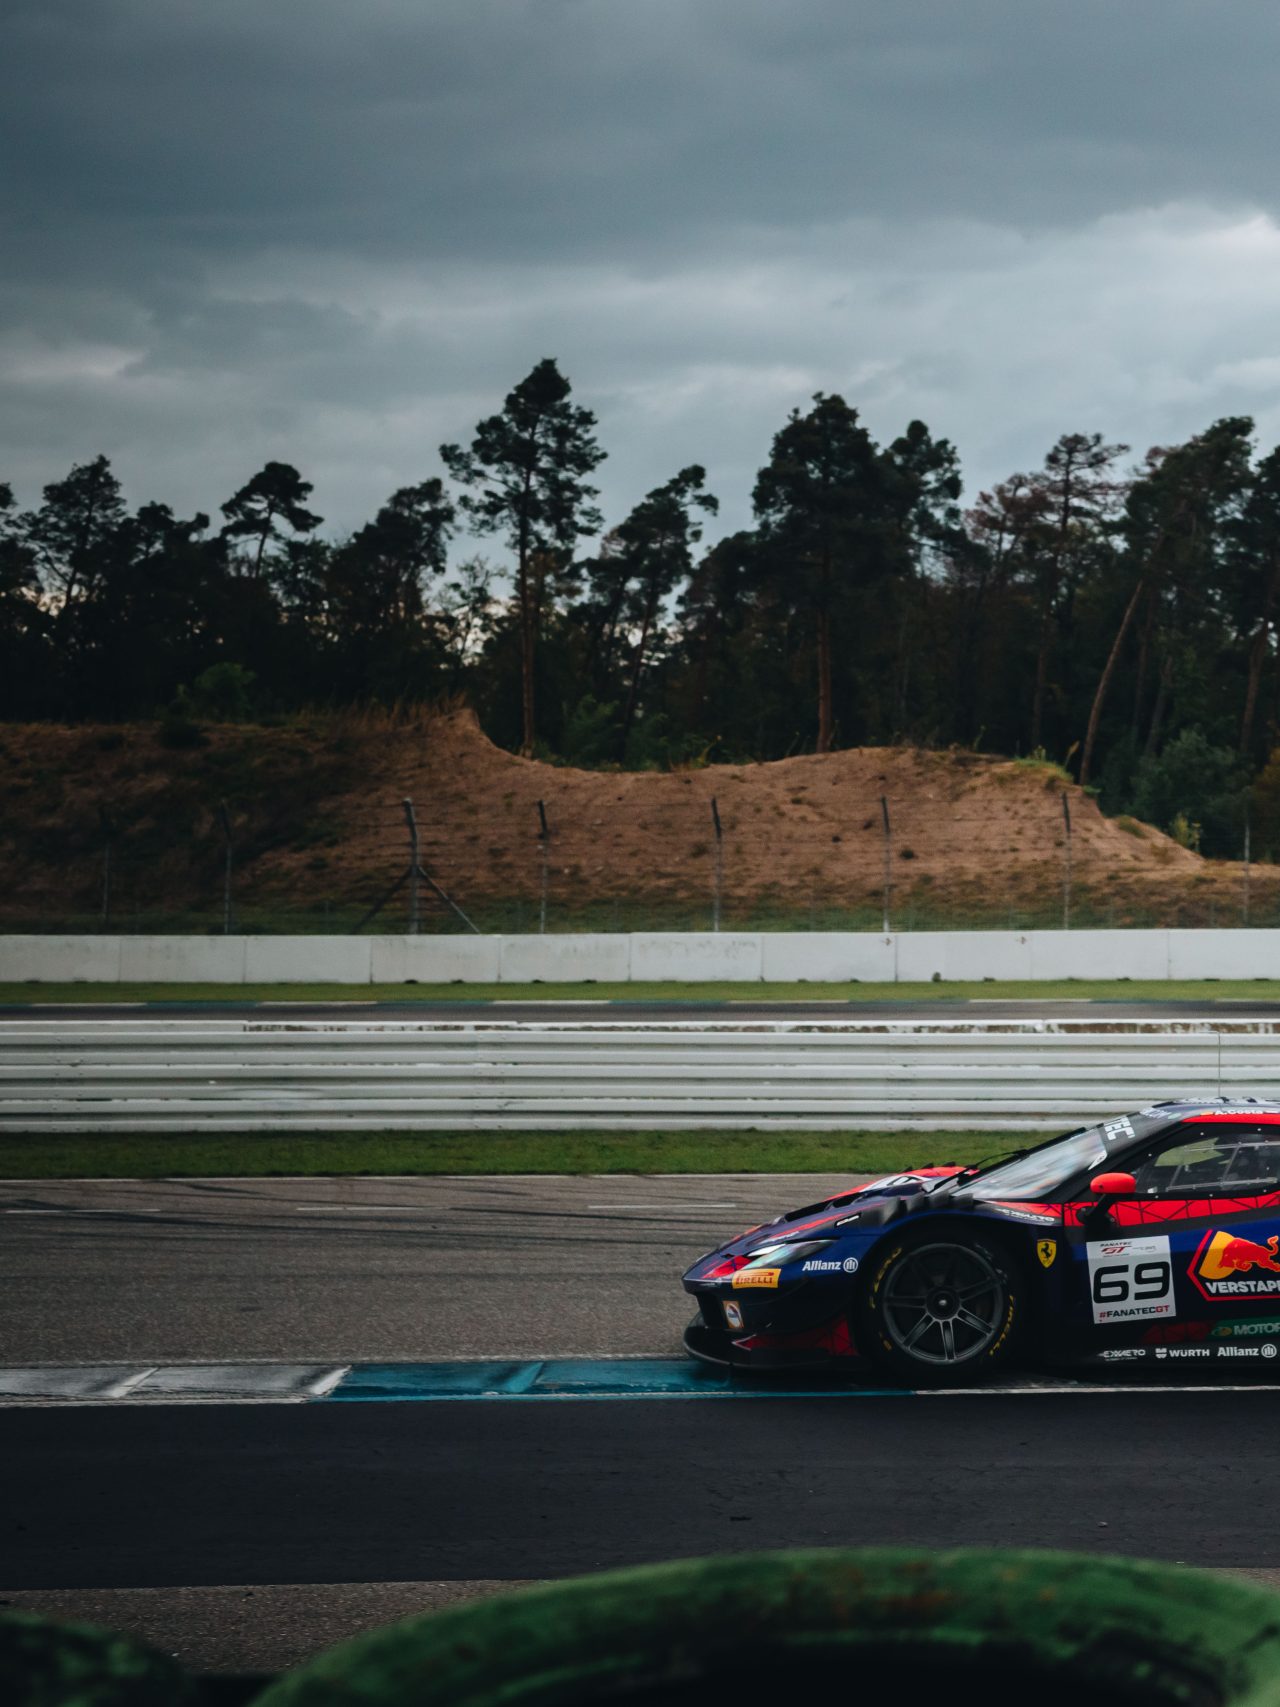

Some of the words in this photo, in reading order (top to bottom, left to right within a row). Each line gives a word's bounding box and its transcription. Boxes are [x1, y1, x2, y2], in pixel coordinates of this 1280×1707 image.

[802, 1260, 842, 1272] Allianz
[1093, 1261, 1171, 1304] 69
[1099, 1304, 1170, 1319] #FANATECGT
[1217, 1346, 1260, 1357] Allianz
